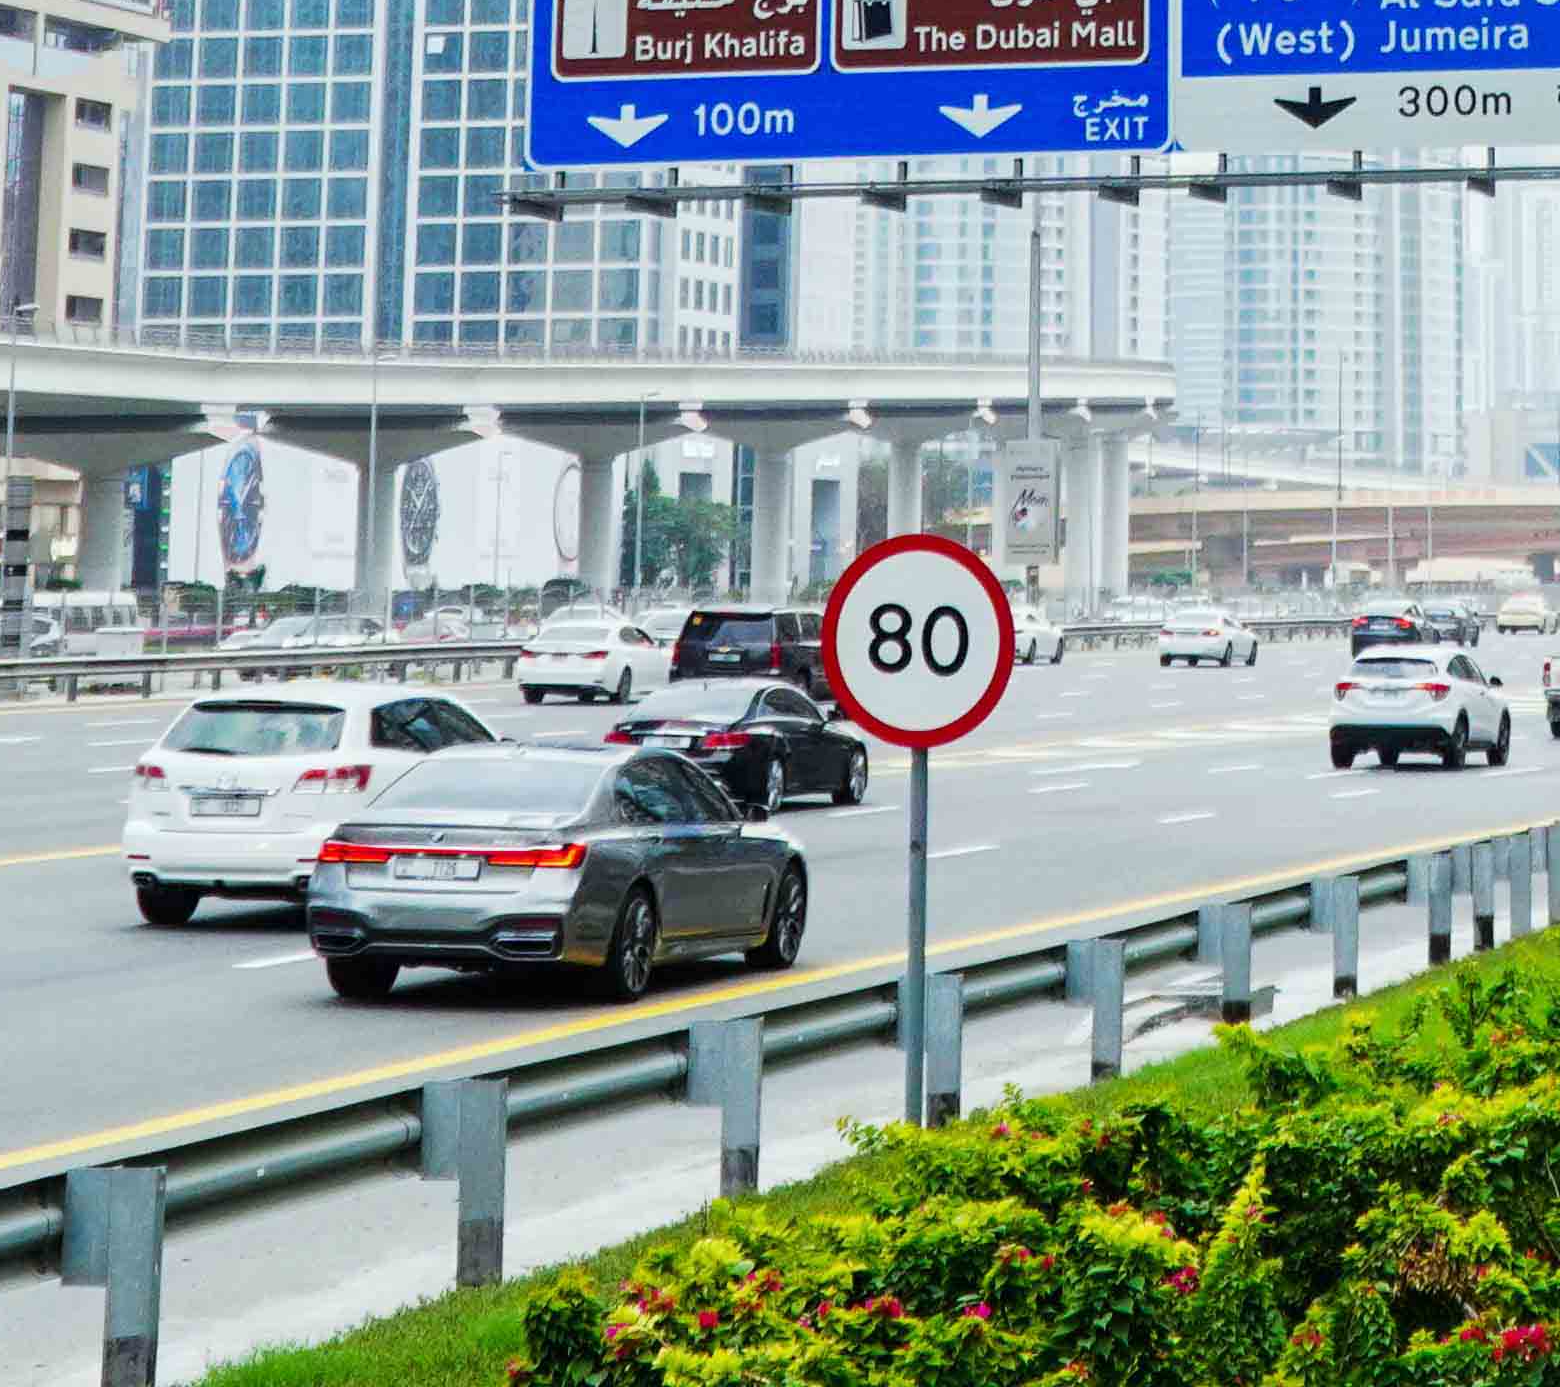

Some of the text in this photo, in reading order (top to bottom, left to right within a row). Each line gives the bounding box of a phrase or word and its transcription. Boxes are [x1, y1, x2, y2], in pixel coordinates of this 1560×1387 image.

[635, 32, 806, 65] Burj Khalifa
[915, 19, 1136, 53] The Dubai Mall
[1216, 22, 1356, 65] (West)
[1380, 17, 1529, 54] Jumeira
[1072, 89, 1150, 116] مخرج
[1398, 86, 1512, 118] 300m
[694, 102, 795, 137] 100m
[1084, 115, 1149, 142] EXIT
[868, 603, 969, 676] 80
